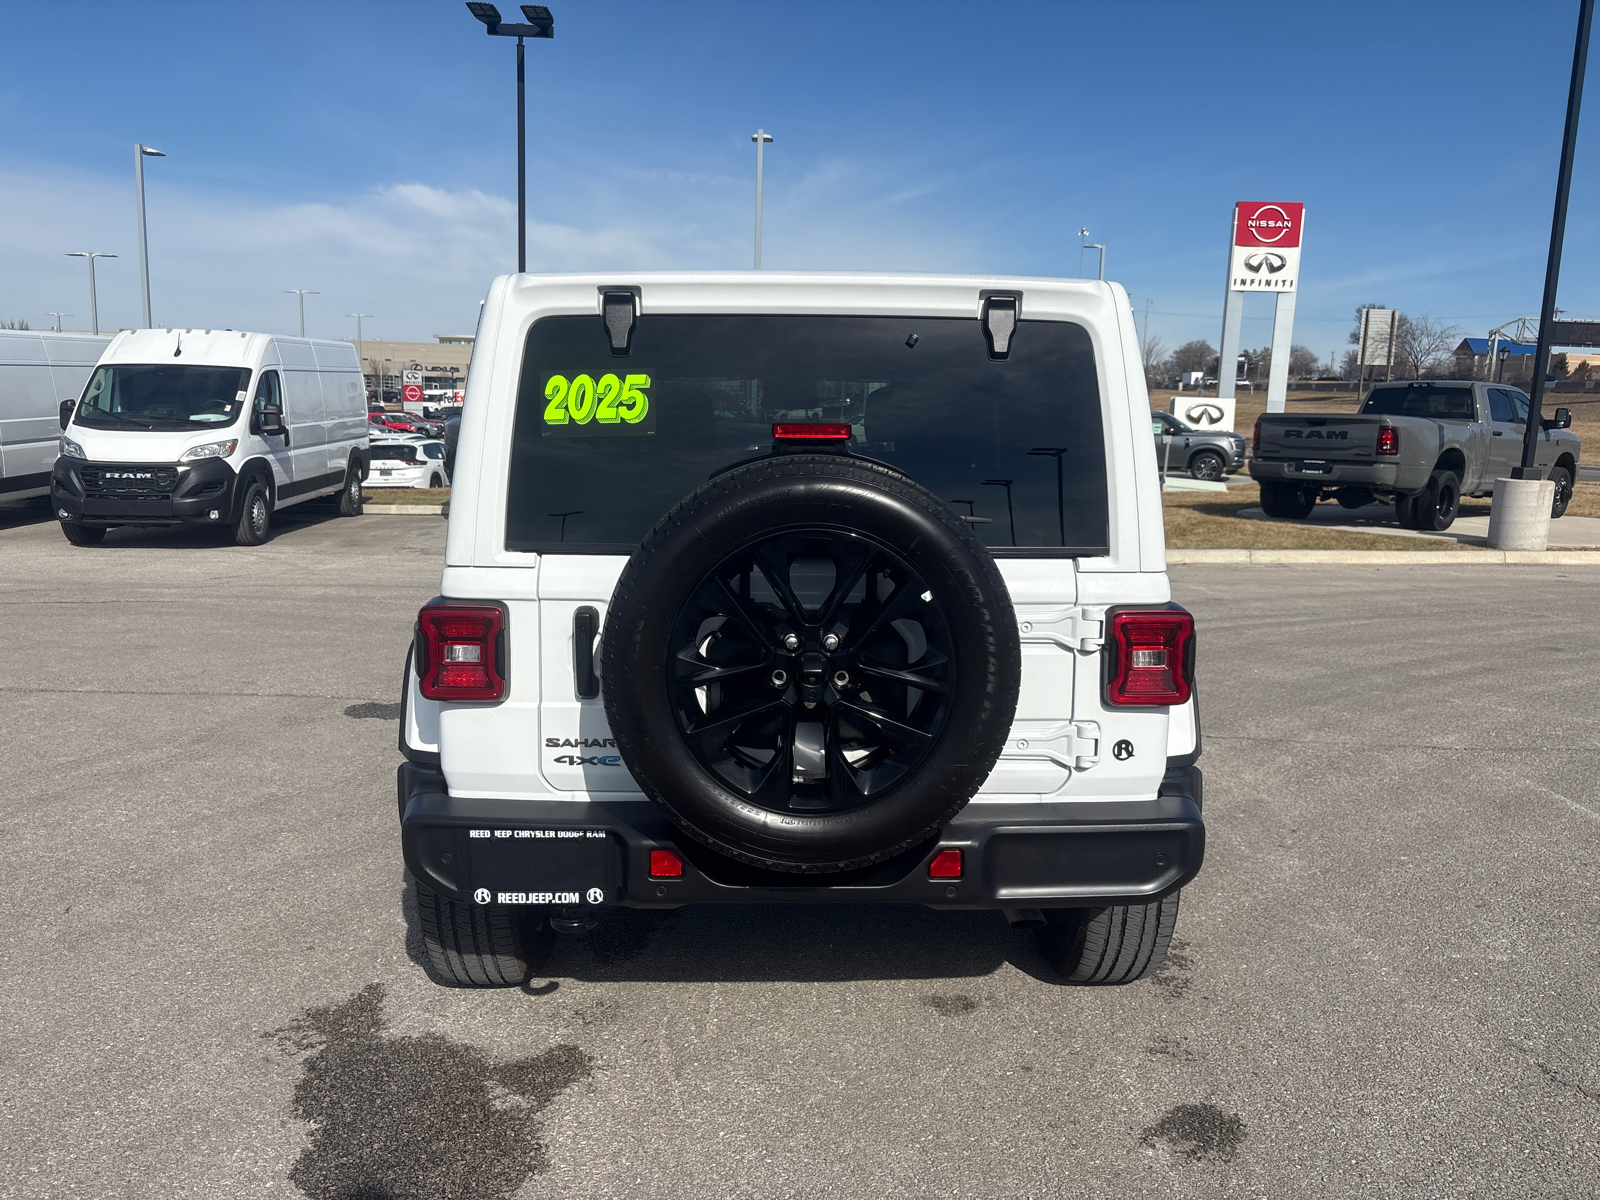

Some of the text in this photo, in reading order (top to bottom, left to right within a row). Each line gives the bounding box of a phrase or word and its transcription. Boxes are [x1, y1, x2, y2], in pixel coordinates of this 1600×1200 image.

[1248, 220, 1292, 228] NISSAN
[1233, 278, 1294, 288] INFINITI
[544, 373, 651, 425] 2025
[1283, 429, 1349, 440] RAM
[545, 737, 617, 748] SAHAR
[469, 829, 491, 838] REED
[514, 829, 556, 838] CHRYSLER
[586, 830, 606, 839] RAM
[497, 892, 580, 904] REEDJEEP.COM
